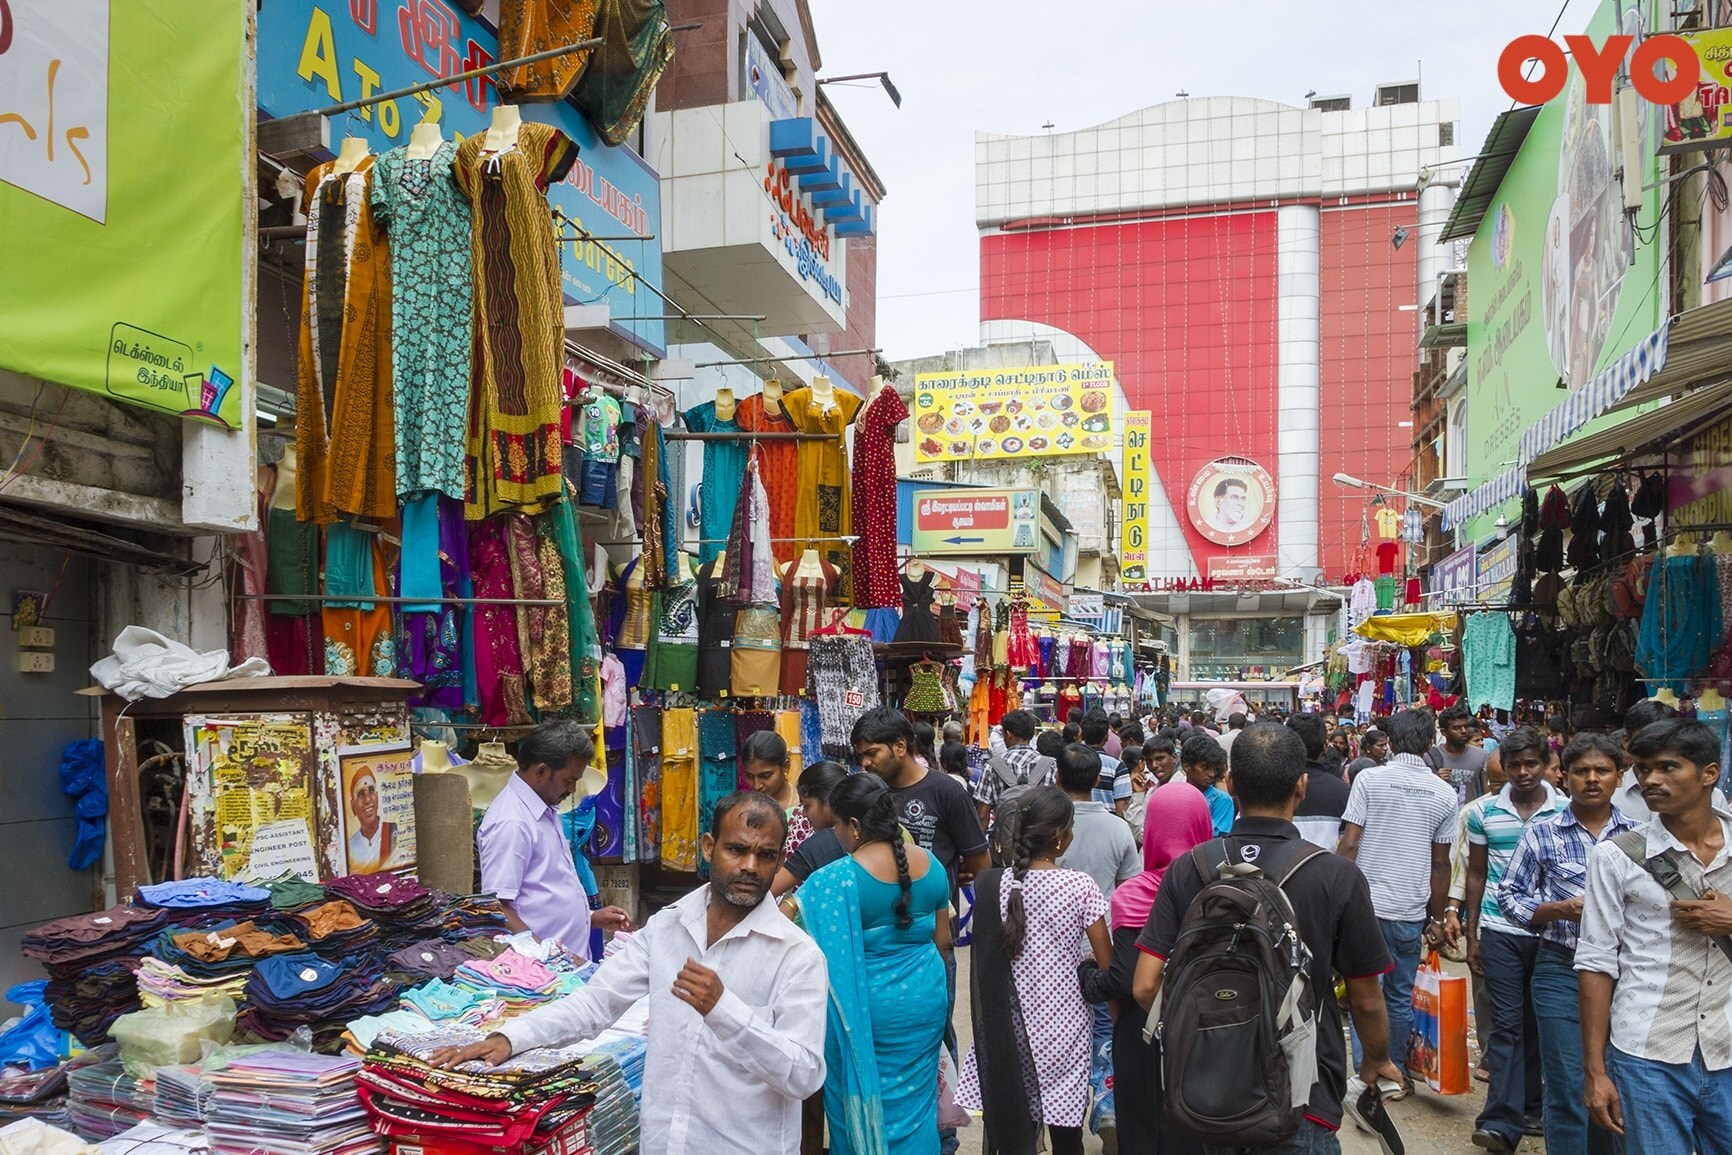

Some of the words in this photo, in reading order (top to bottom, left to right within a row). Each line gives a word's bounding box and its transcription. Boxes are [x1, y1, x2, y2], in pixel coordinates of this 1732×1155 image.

[297, 6, 341, 103] A
[354, 56, 400, 138] To
[1700, 85, 1732, 108] TA
[558, 157, 650, 236] டையகம்
[113, 339, 184, 373] டெக்ஸ்டைல்
[137, 366, 184, 393] இந்தியா
[918, 373, 991, 391] காரைக்குடி
[995, 368, 1067, 386] செட்டிநாடு
[1071, 365, 1111, 381] மெஸ்
[590, 407, 600, 417] 10
[1125, 430, 1147, 548] செட்டிநாடு
[848, 693, 861, 705] 150
[289, 840, 307, 848] POST
[271, 856, 311, 867] ENGINEERING
